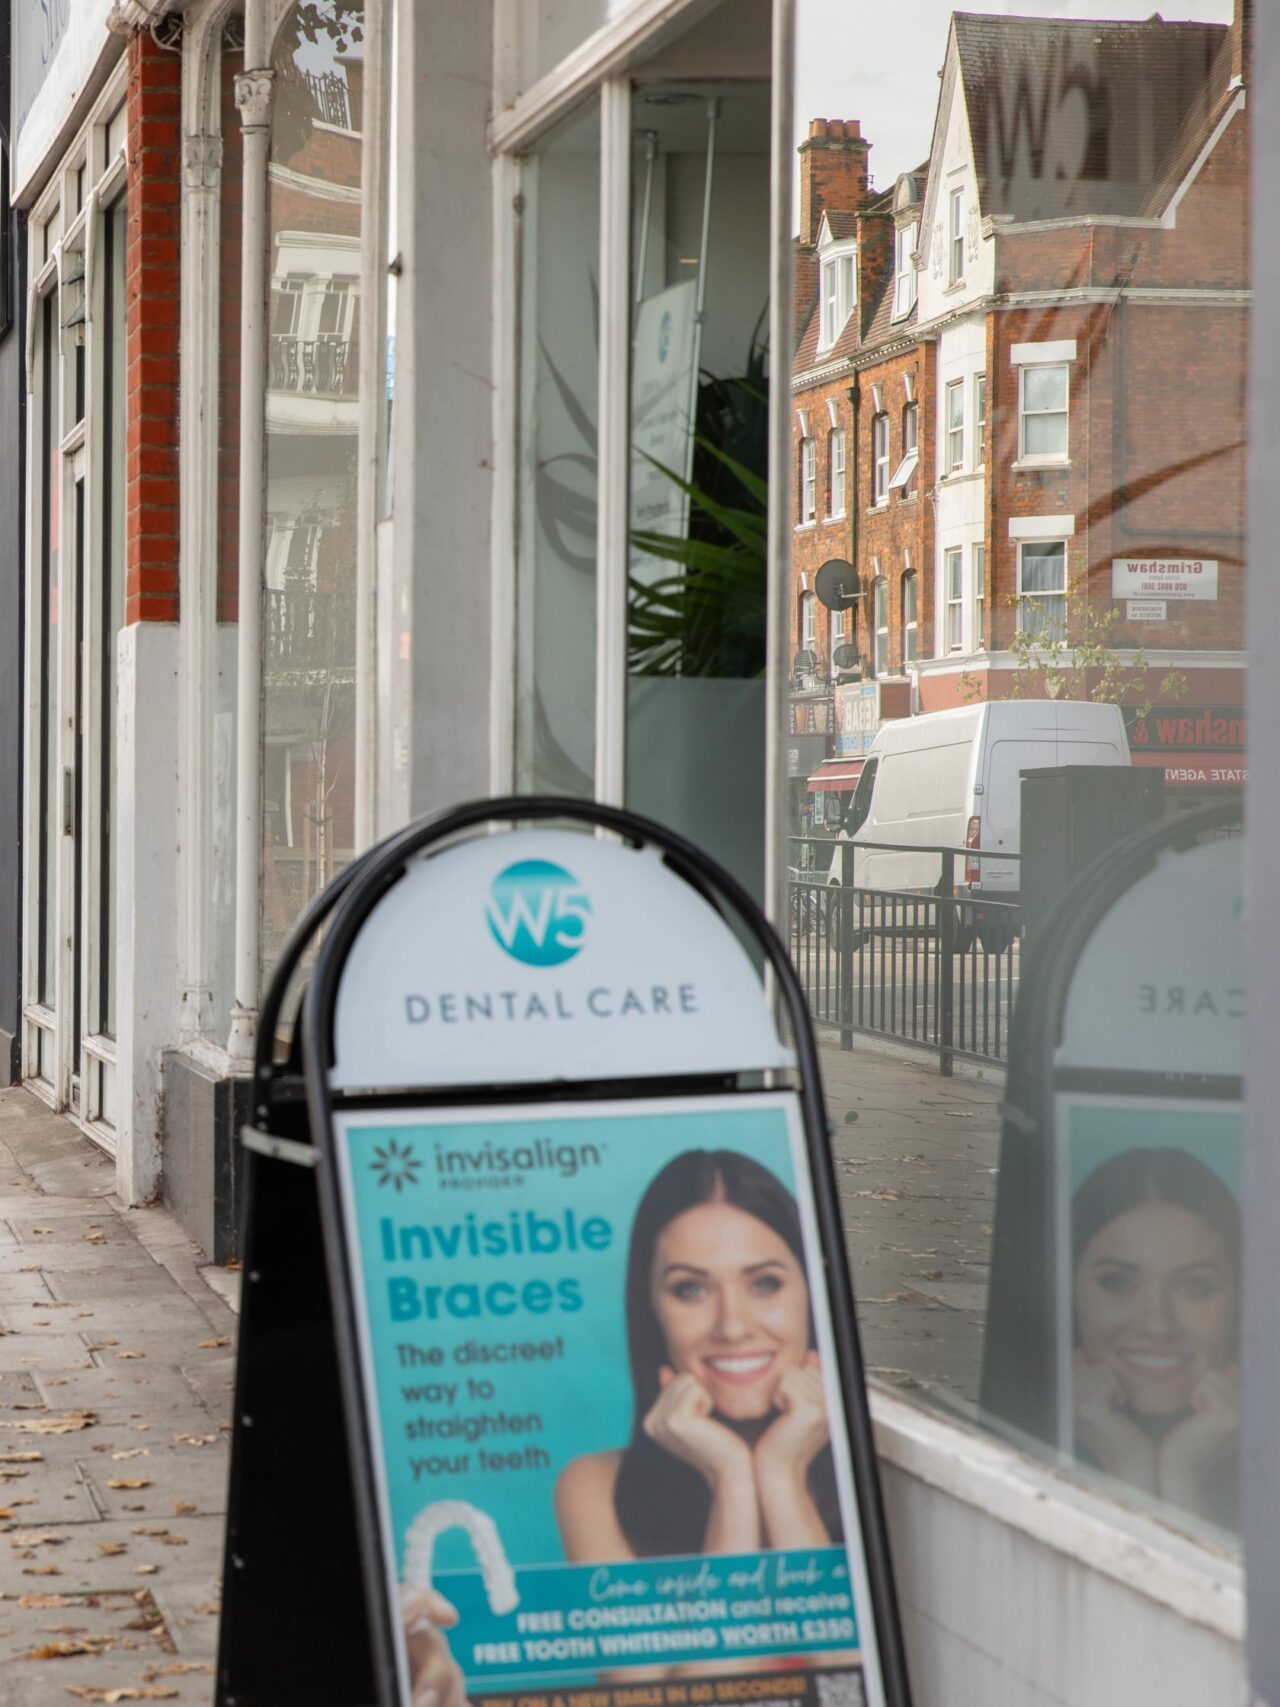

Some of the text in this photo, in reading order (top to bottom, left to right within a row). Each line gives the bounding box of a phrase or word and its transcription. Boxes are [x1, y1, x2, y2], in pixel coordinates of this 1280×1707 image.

[486, 884, 593, 951] W5
[404, 984, 699, 1025] DENTAL CARE
[434, 1136, 602, 1178] invisalign
[379, 1208, 614, 1263] Invisible
[387, 1276, 586, 1323] Braces
[395, 1336, 565, 1369] The discreet
[401, 1377, 495, 1408] way to
[404, 1412, 543, 1444] straighten
[408, 1447, 551, 1481] your teeth
[516, 1591, 850, 1635] FREE CONSULTATION and receive
[473, 1642, 521, 1666] FREE
[524, 1636, 597, 1662] TOOTH
[599, 1627, 717, 1657] WHITENING
[722, 1619, 798, 1650] WORTH
[666, 1684, 688, 1703] IN
